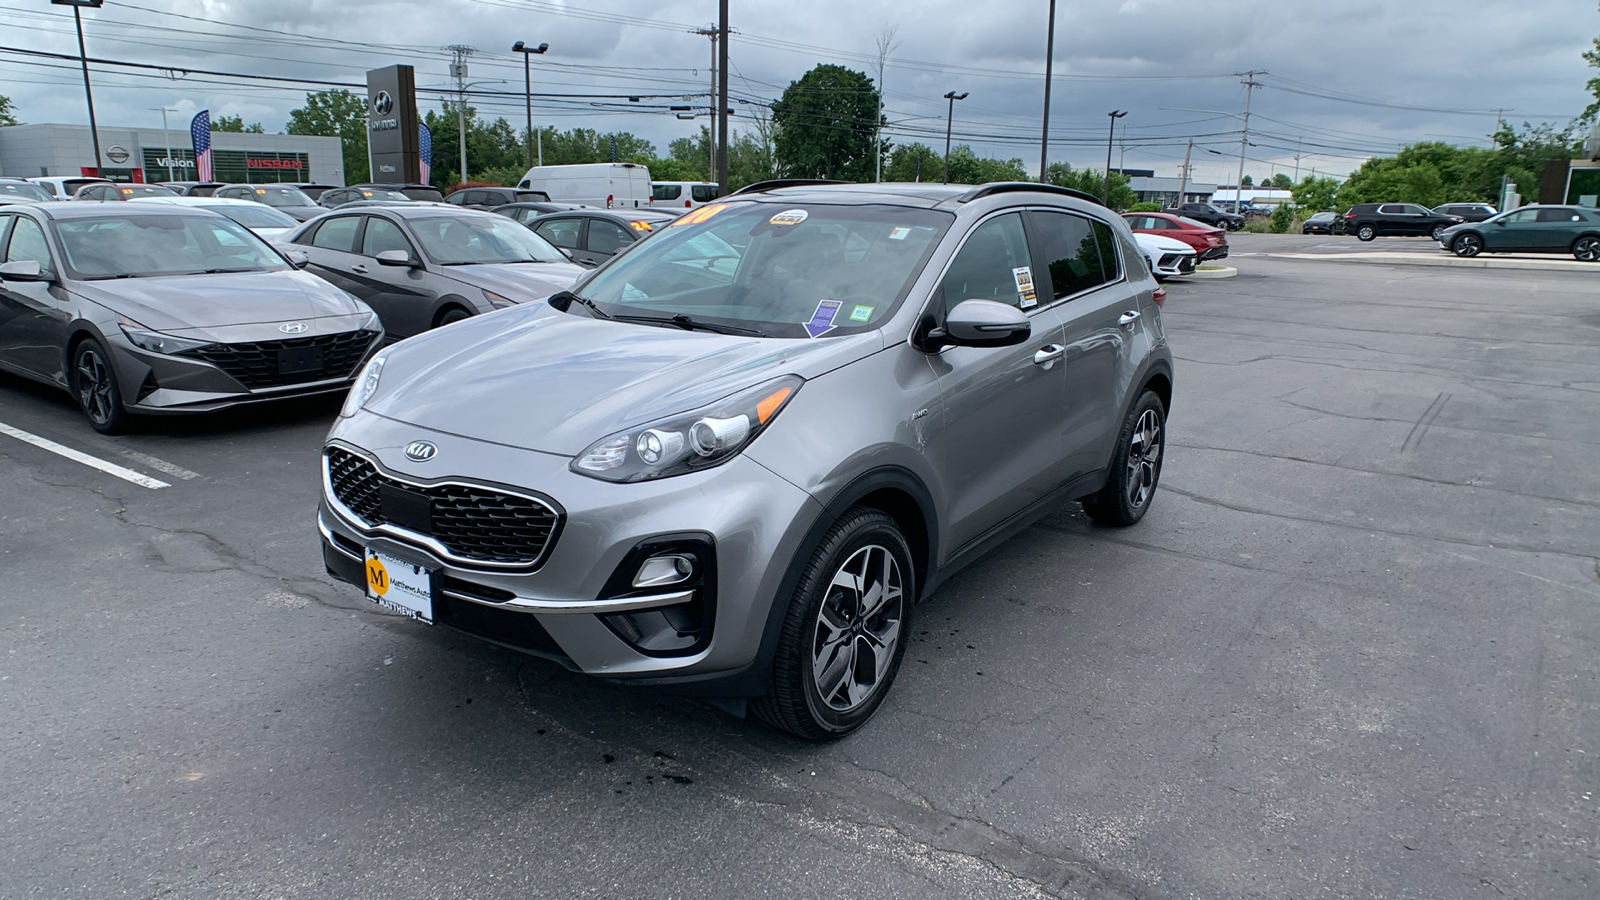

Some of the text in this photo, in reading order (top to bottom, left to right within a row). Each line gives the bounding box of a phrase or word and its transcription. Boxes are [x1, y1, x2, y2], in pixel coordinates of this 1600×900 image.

[156, 157, 194, 167] Vision
[247, 159, 303, 169] NISSAN
[672, 204, 729, 226] 20
[630, 221, 652, 231] 24
[912, 408, 928, 420] AWD
[407, 443, 431, 458] KIA
[369, 566, 385, 588] M
[390, 577, 416, 594] Matthews
[416, 587, 431, 599] Auto
[379, 598, 417, 620] MATTHEWS
